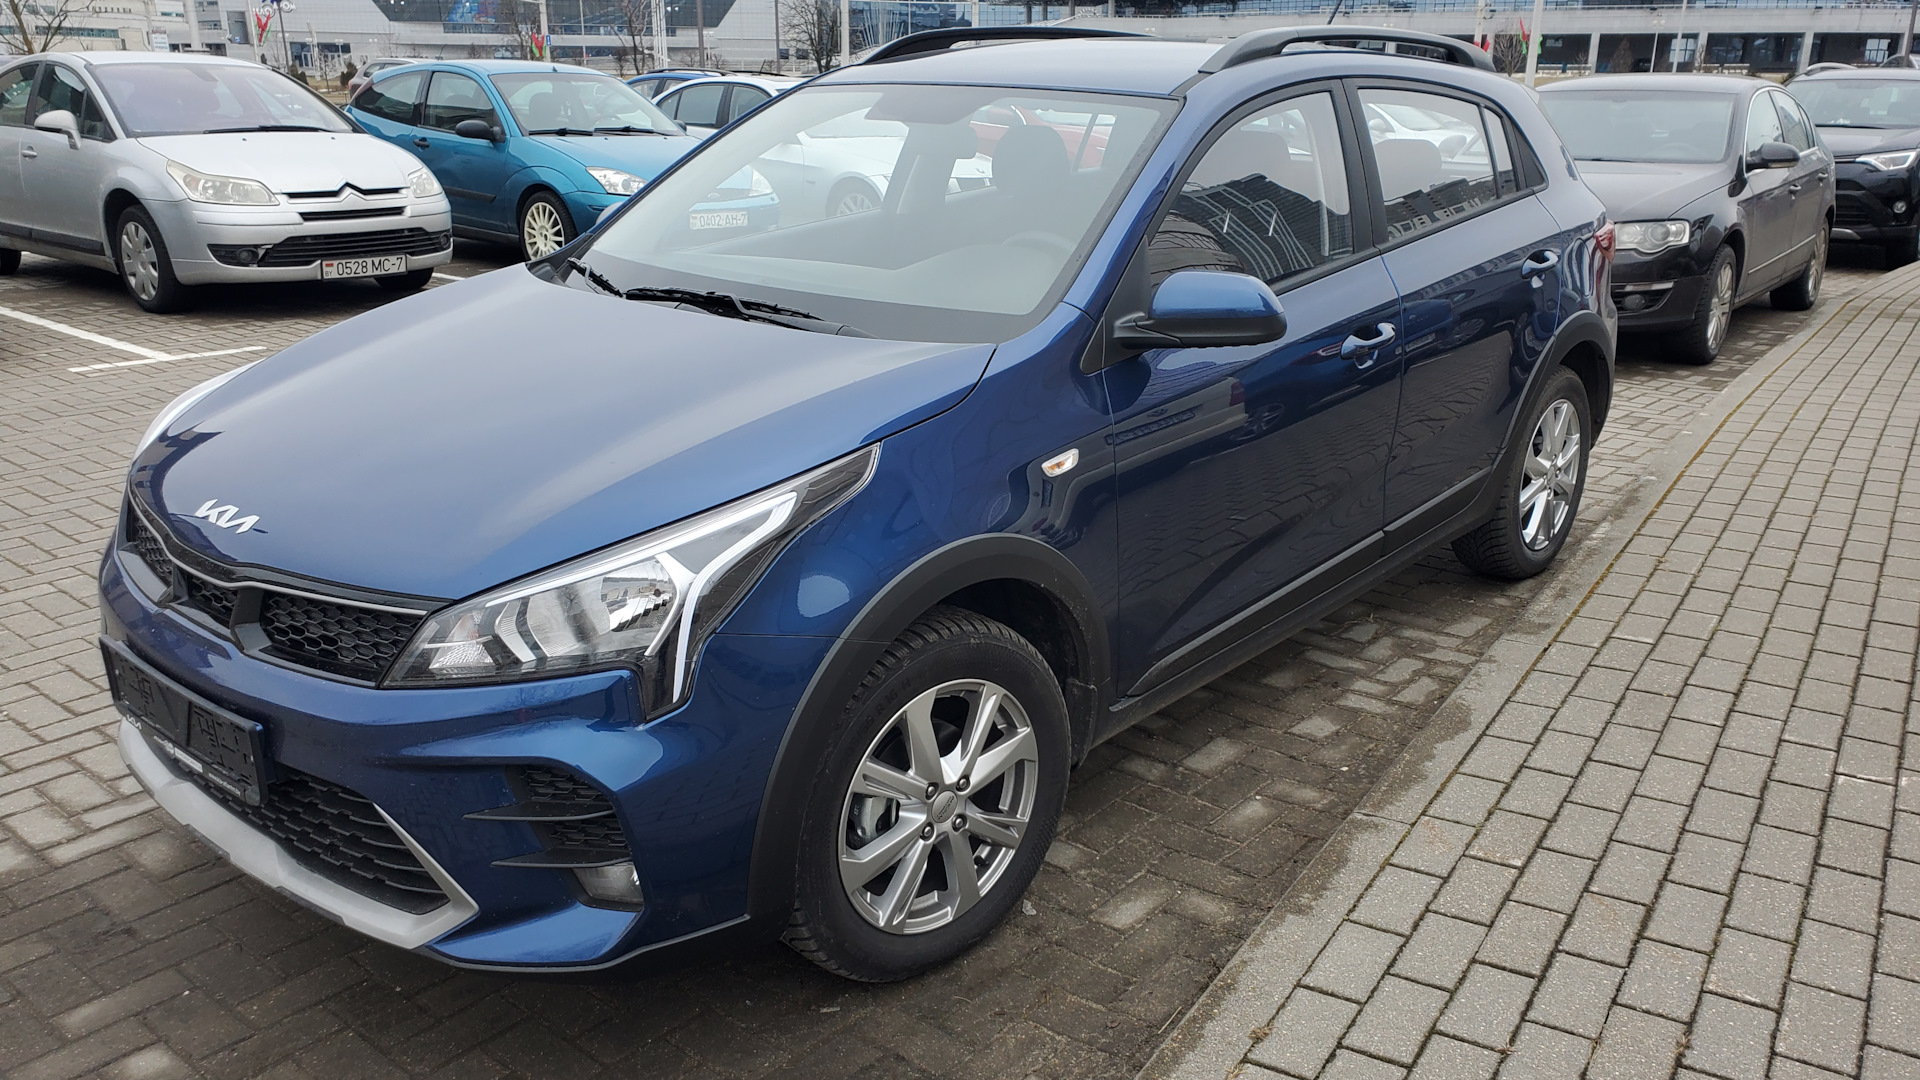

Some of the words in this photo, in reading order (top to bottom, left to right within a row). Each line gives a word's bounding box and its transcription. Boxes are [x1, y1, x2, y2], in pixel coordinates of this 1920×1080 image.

[699, 214, 722, 227] 0402
[336, 260, 368, 276] 0528
[371, 256, 403, 274] MC-7
[194, 498, 260, 534] KIA
[126, 713, 142, 730] KIA
